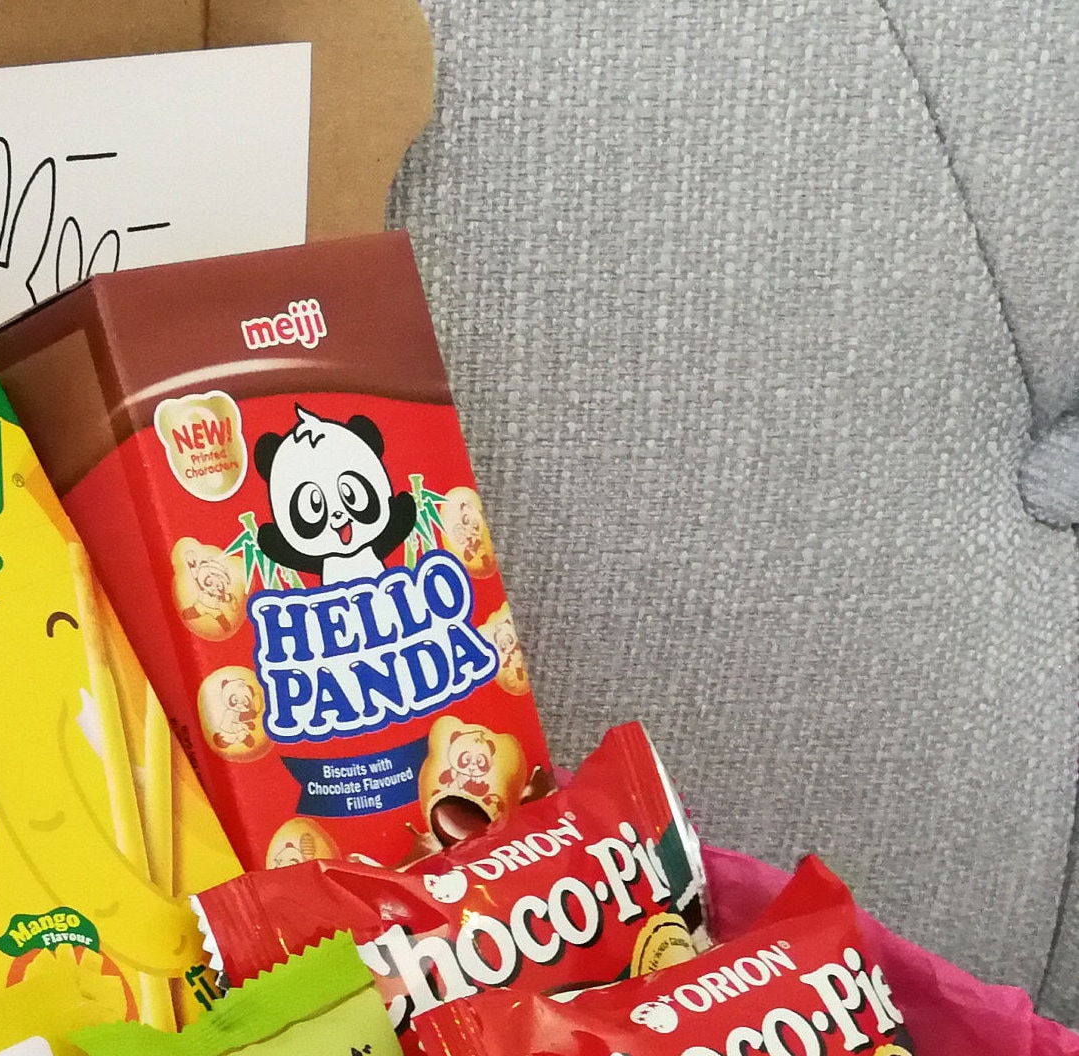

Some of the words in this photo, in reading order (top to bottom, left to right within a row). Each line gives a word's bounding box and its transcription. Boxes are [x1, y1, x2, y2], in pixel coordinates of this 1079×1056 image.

[243, 299, 326, 349] meiji
[171, 416, 233, 454] NEW!
[255, 561, 466, 664] HELLO
[264, 622, 494, 728] PANDA
[307, 779, 361, 796] Chocolate
[363, 768, 414, 791] Flavoured
[323, 762, 367, 779] Biscuits
[369, 758, 393, 774] with
[346, 794, 383, 811] Filling
[9, 913, 81, 948] Mango
[41, 933, 93, 946] Flavour
[674, 944, 799, 1013] ORION
